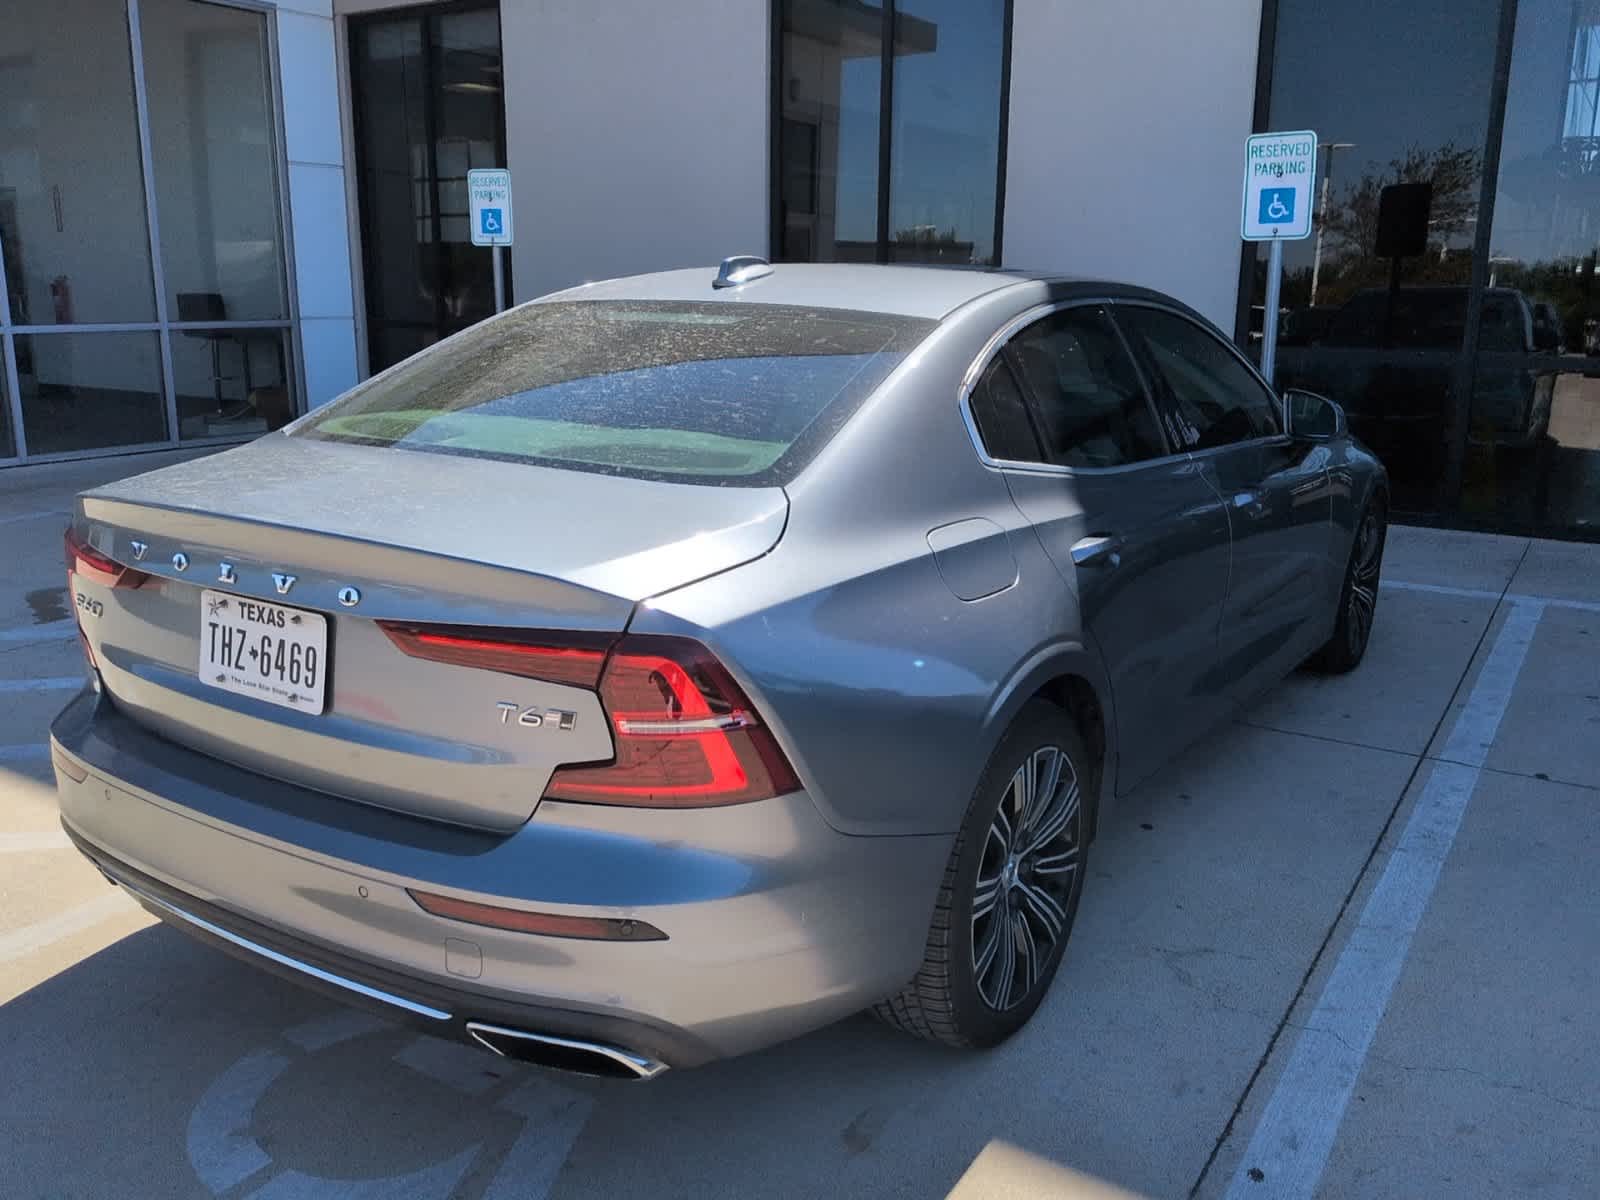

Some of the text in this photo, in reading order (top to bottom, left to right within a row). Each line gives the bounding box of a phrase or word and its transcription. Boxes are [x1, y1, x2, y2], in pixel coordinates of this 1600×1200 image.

[1251, 143, 1311, 158] RESERVED
[1254, 161, 1306, 176] PARKING
[131, 541, 362, 607] VOLVO
[238, 601, 285, 628] TEXAS
